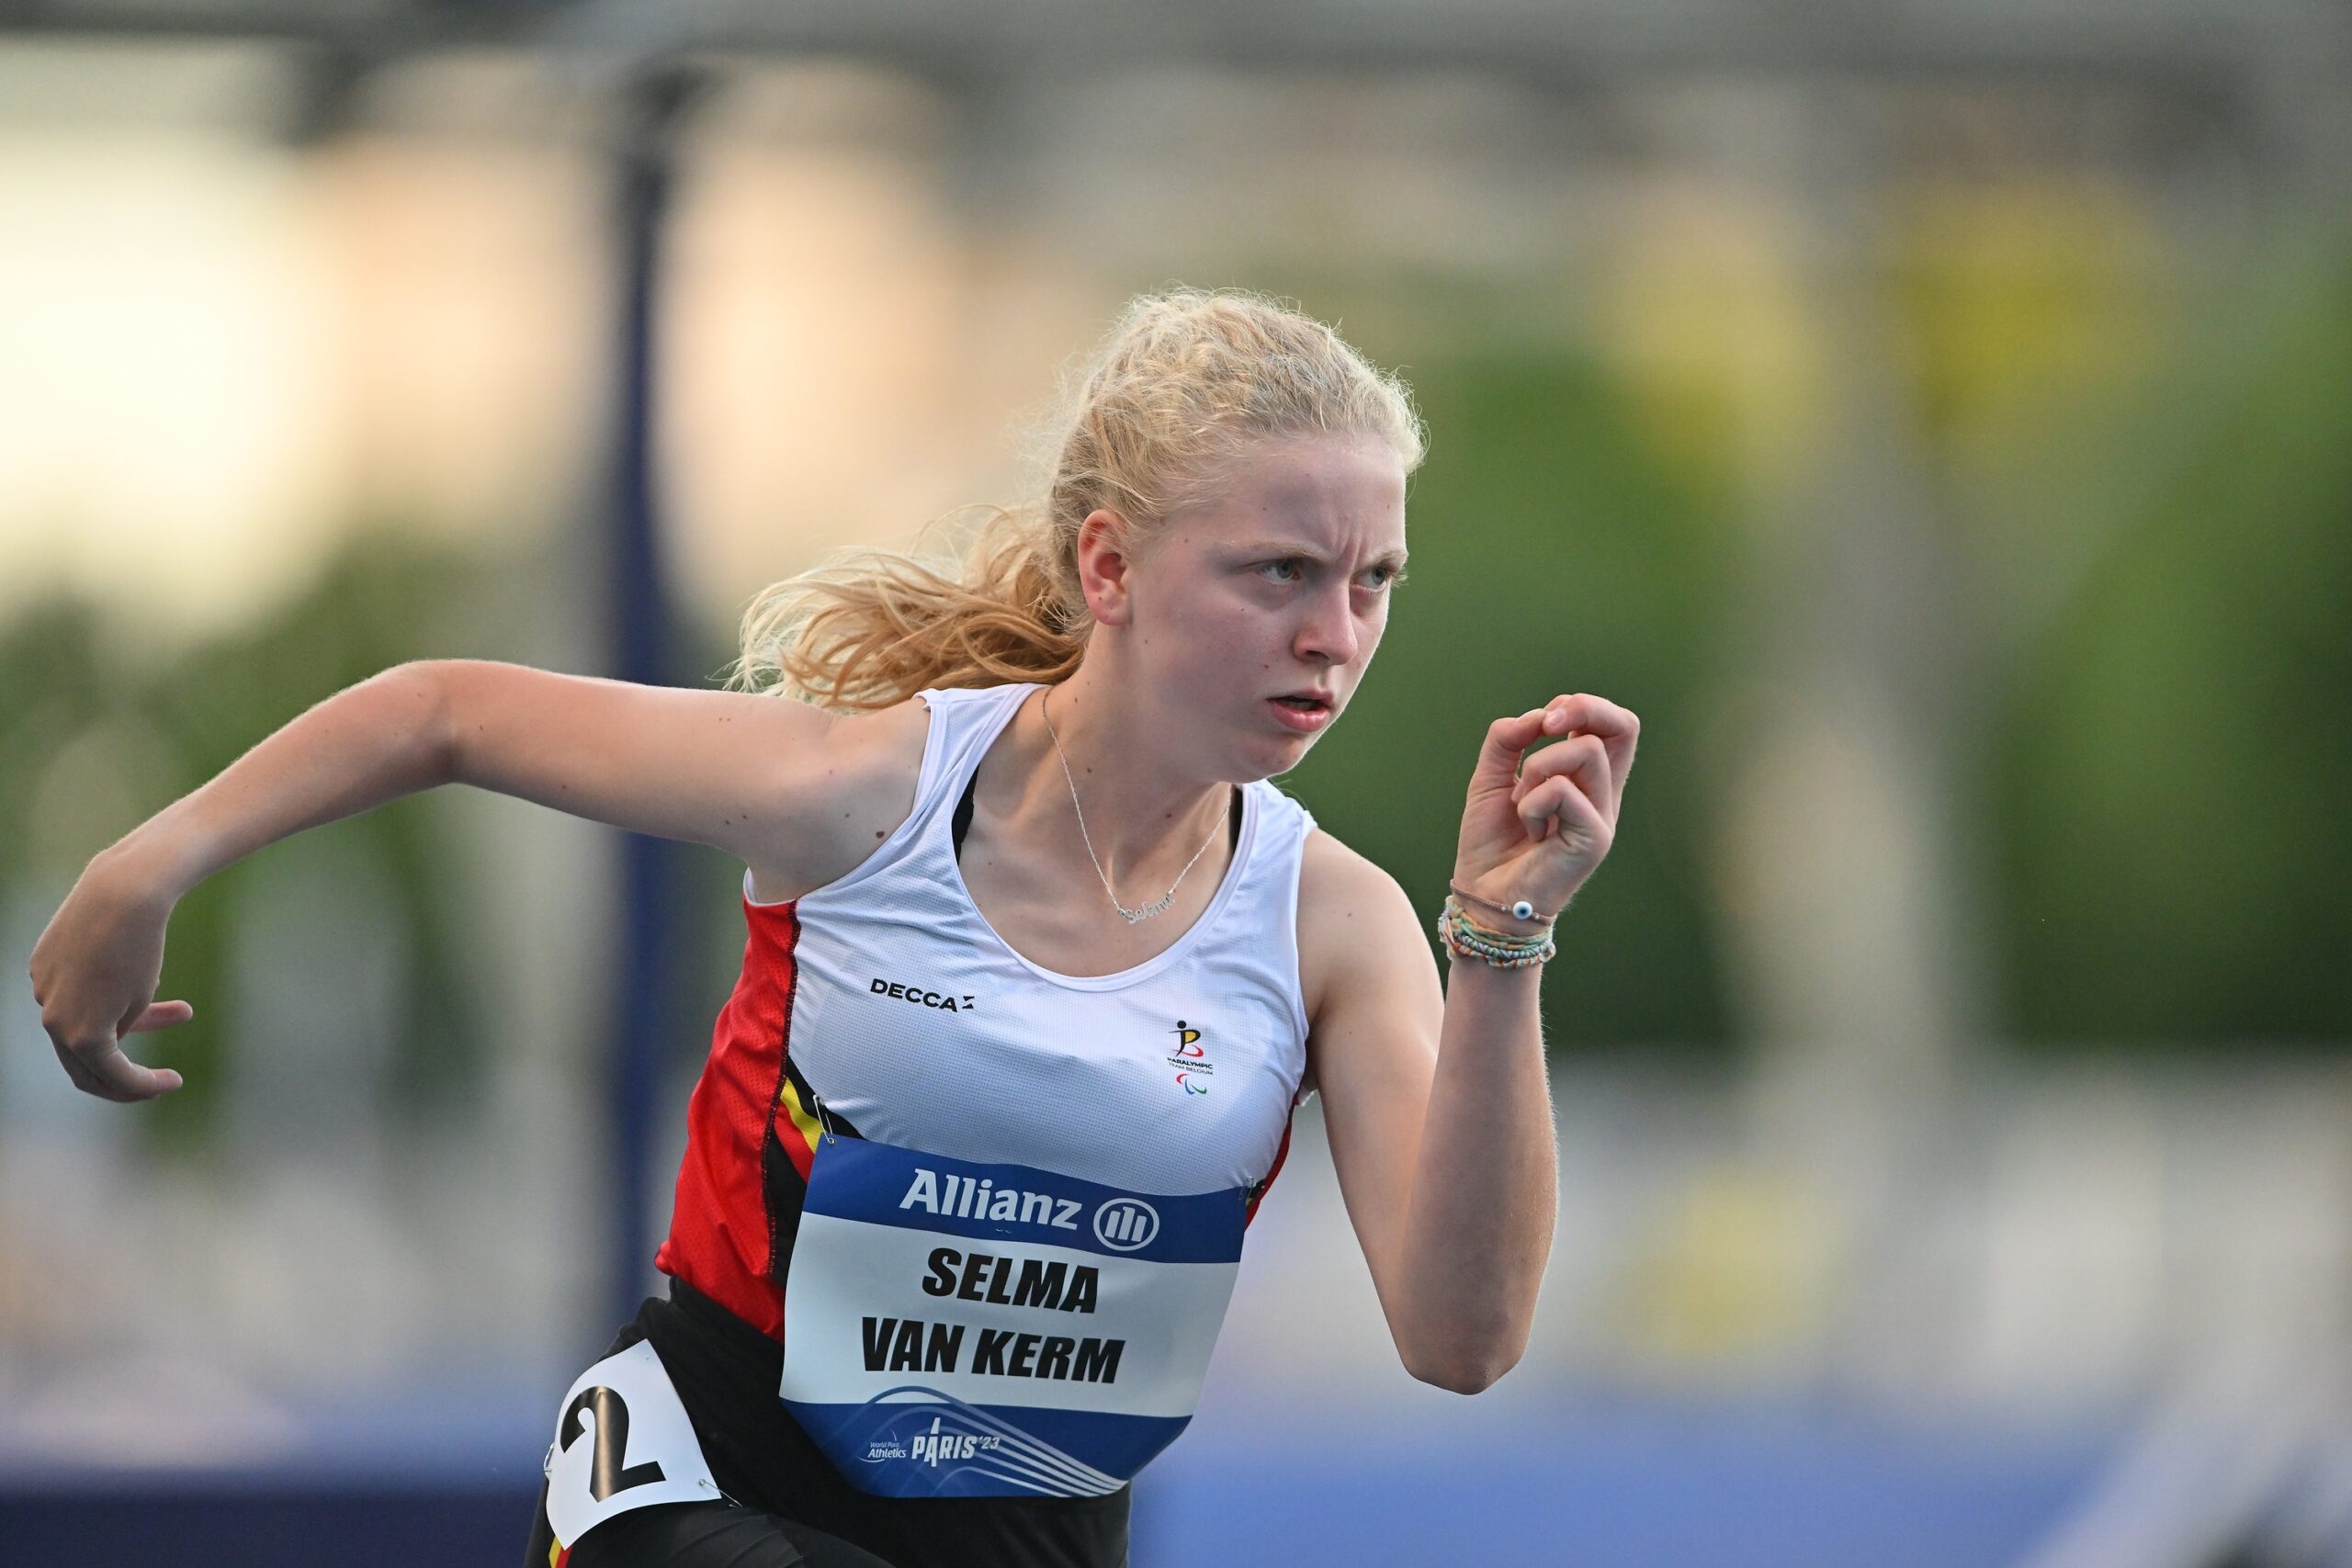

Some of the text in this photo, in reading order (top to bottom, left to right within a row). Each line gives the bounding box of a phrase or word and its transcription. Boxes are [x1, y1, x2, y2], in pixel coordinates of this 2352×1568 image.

[870, 978, 957, 1012] DECCA
[1167, 1057, 1213, 1069] PARALYMPIC
[1186, 1066, 1213, 1075] BELGIUM
[899, 1168, 1082, 1231] Allianz
[922, 1247, 1099, 1314] SELMA
[862, 1316, 1125, 1383] VAN KERM
[560, 1385, 666, 1503] 2
[867, 1448, 907, 1459] Athletics
